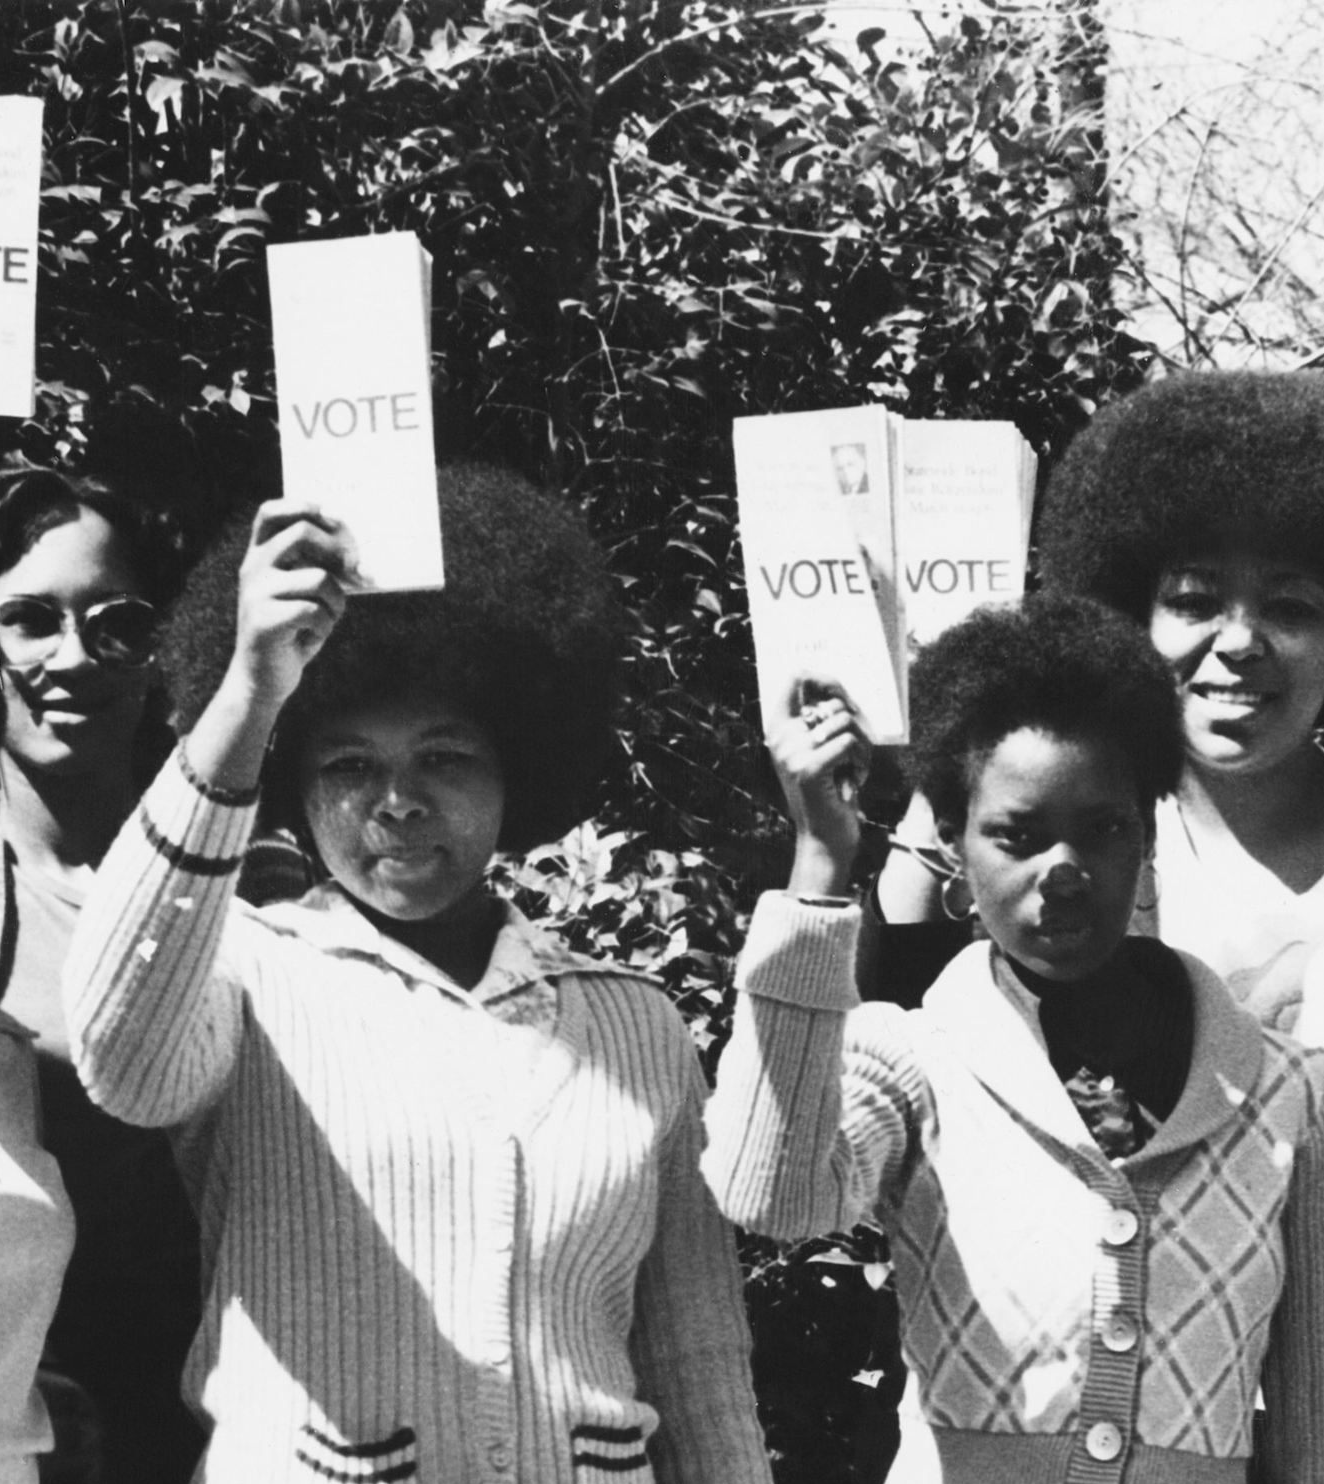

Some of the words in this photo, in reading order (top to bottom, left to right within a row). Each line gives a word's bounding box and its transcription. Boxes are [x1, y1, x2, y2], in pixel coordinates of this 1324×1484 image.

[291, 391, 420, 440] VOTE
[759, 558, 865, 601] VOTE
[905, 558, 1013, 594] VOTE
